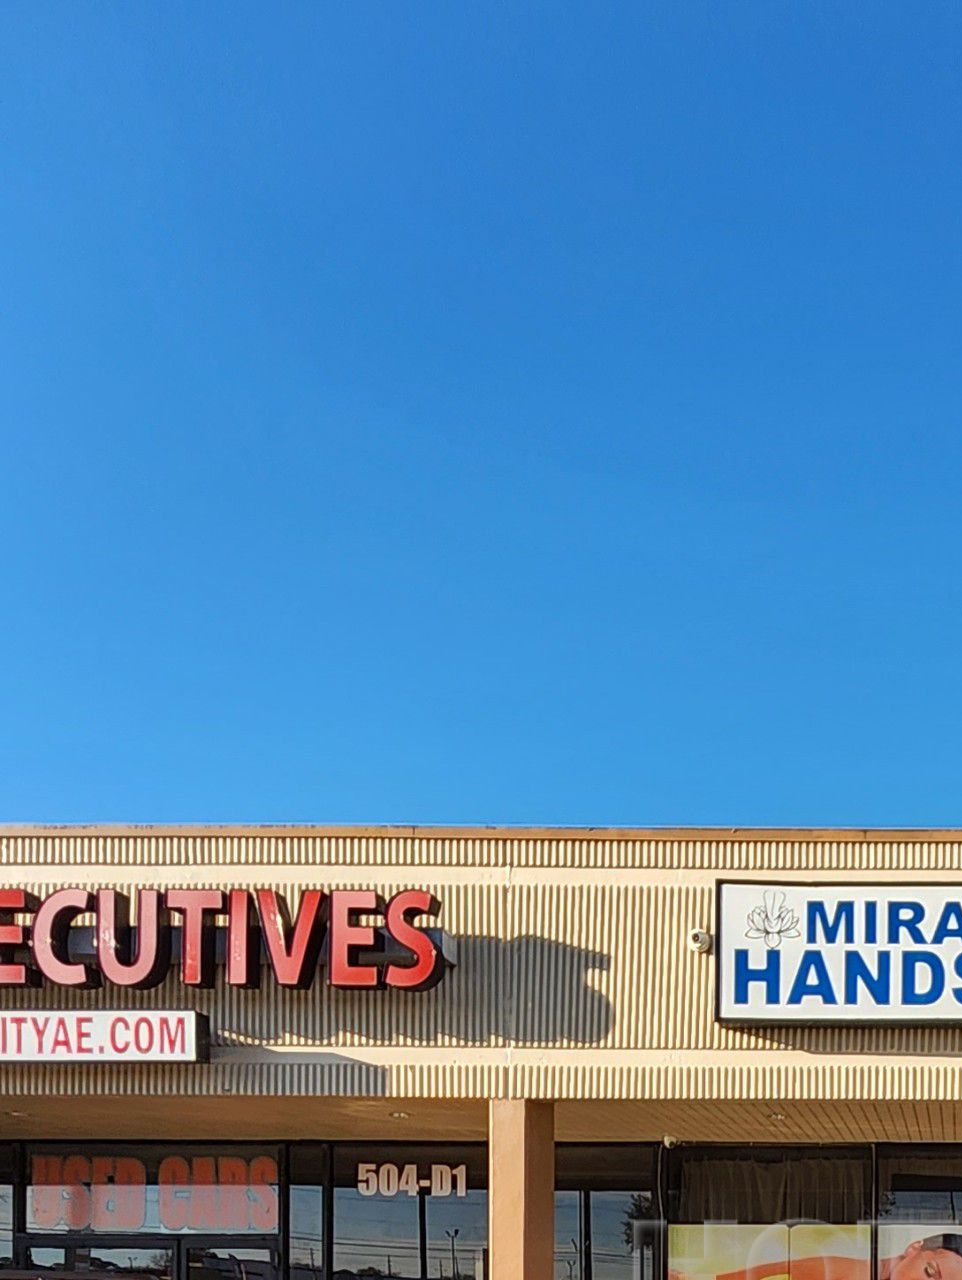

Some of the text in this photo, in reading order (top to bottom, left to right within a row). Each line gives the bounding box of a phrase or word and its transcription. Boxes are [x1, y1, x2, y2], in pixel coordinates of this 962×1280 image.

[0, 888, 438, 987] ECUTIVES
[0, 1016, 185, 1054] ITYAE.COM
[32, 1155, 278, 1230] USED CARS
[357, 1163, 467, 1197] 504-D1
